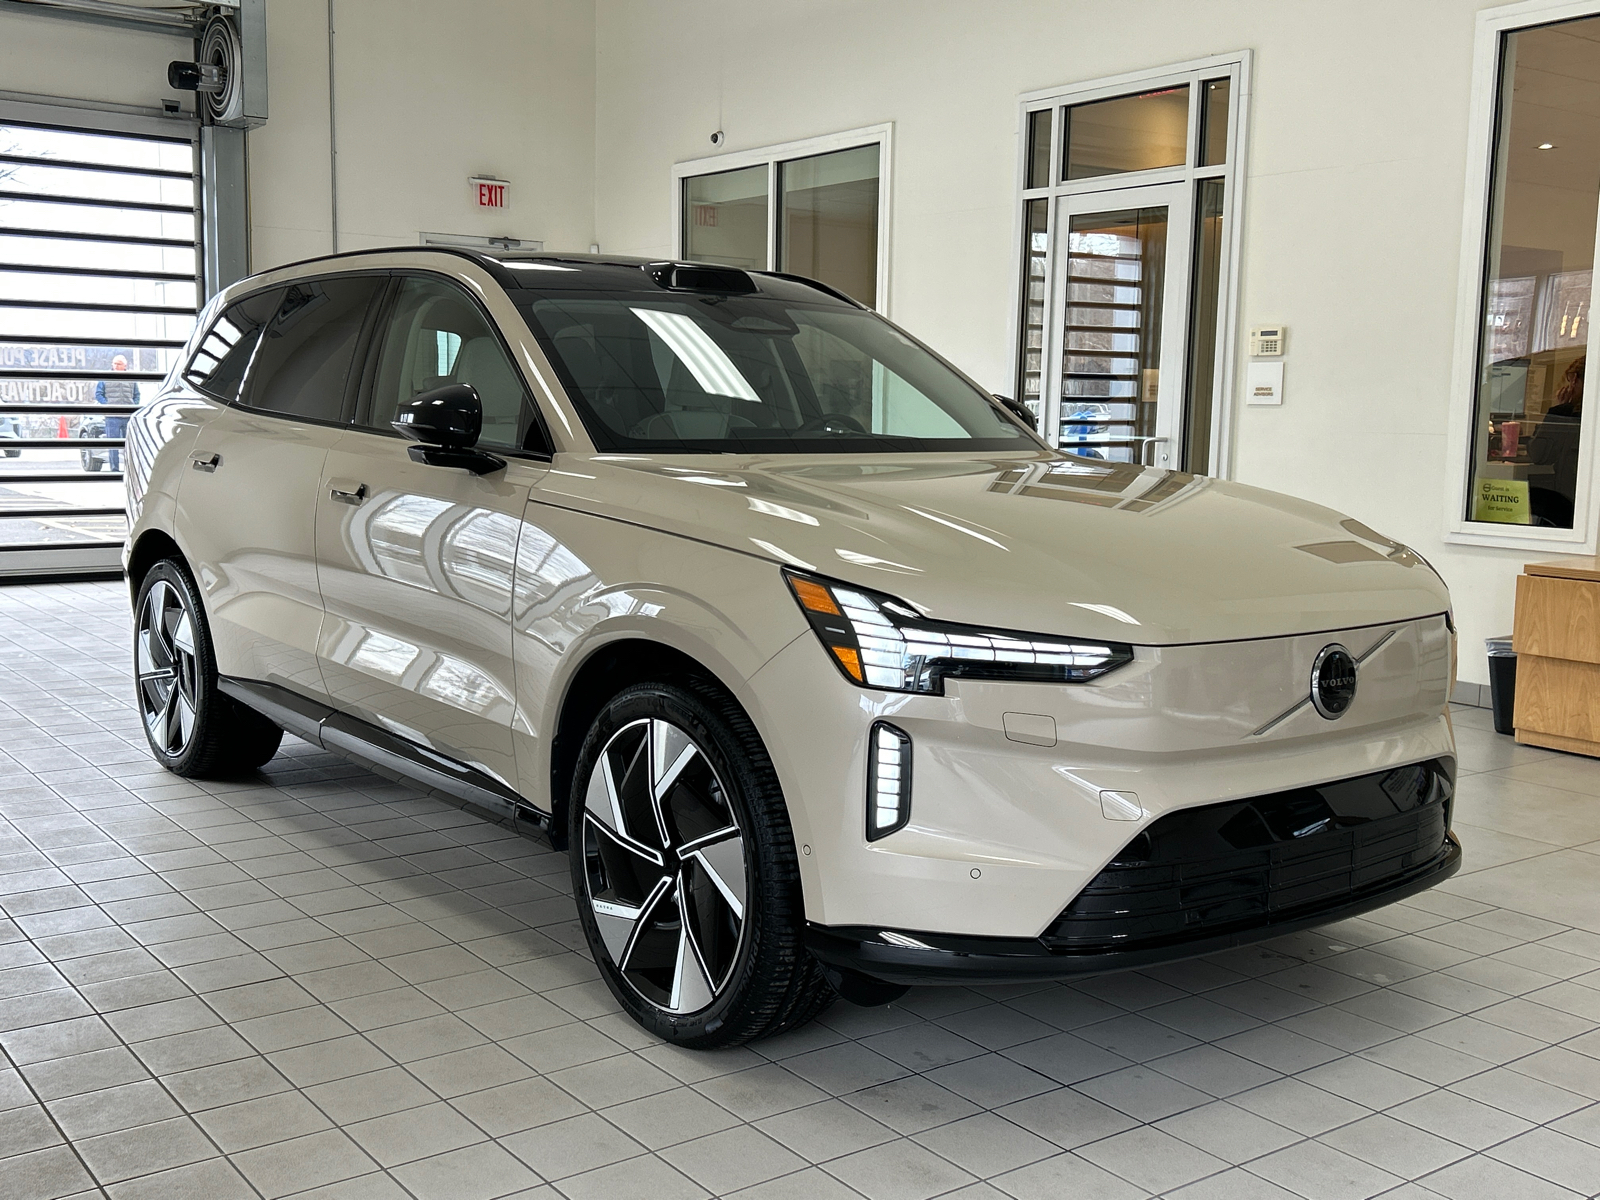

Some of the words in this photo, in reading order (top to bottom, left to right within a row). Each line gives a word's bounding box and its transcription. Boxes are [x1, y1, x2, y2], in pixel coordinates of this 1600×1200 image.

[480, 184, 504, 207] EXIT
[1482, 494, 1519, 504] WAITING
[1320, 676, 1355, 688] VOLVO
